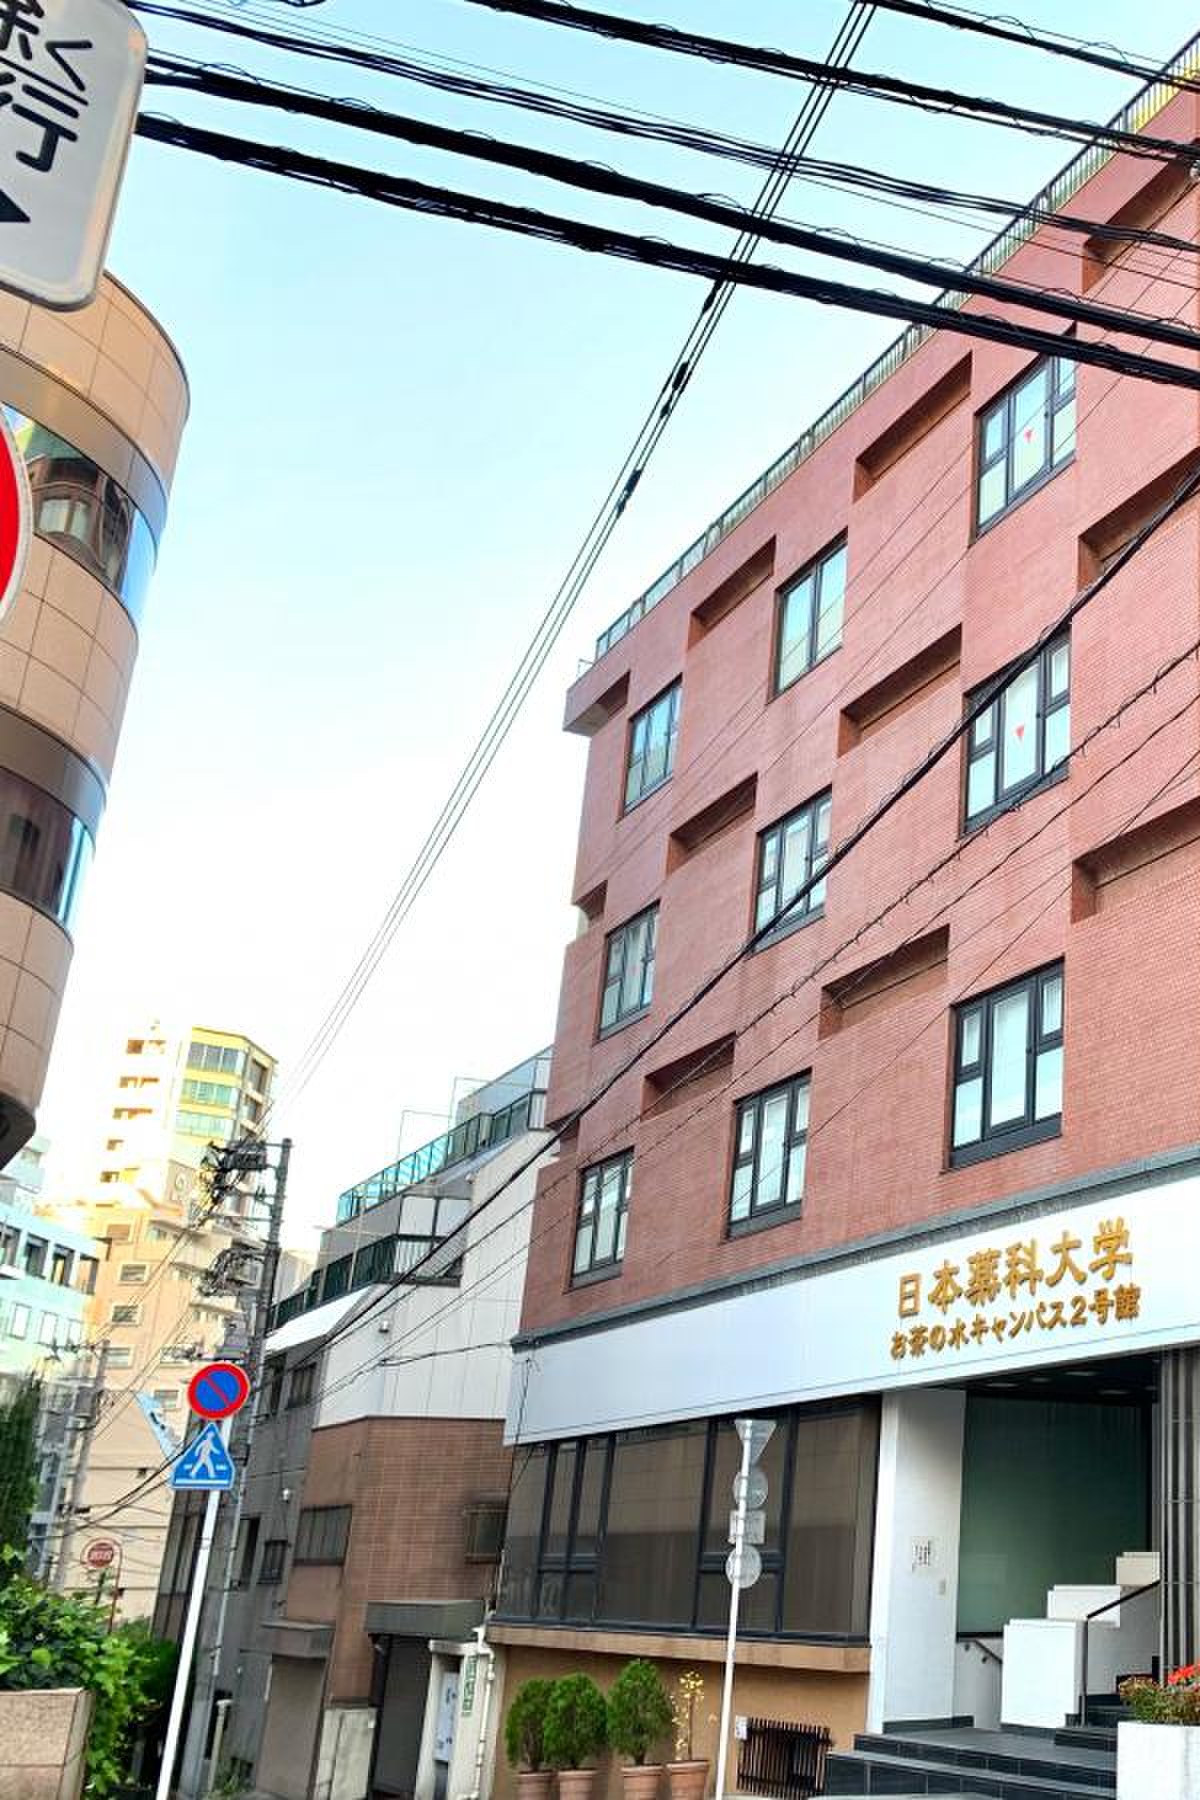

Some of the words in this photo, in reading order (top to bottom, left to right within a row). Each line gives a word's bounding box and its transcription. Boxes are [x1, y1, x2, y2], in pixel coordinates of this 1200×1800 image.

[898, 1217, 1133, 1318] 日本薬科大学
[890, 1283, 1141, 1360] お茶の水キャンパス2号館
